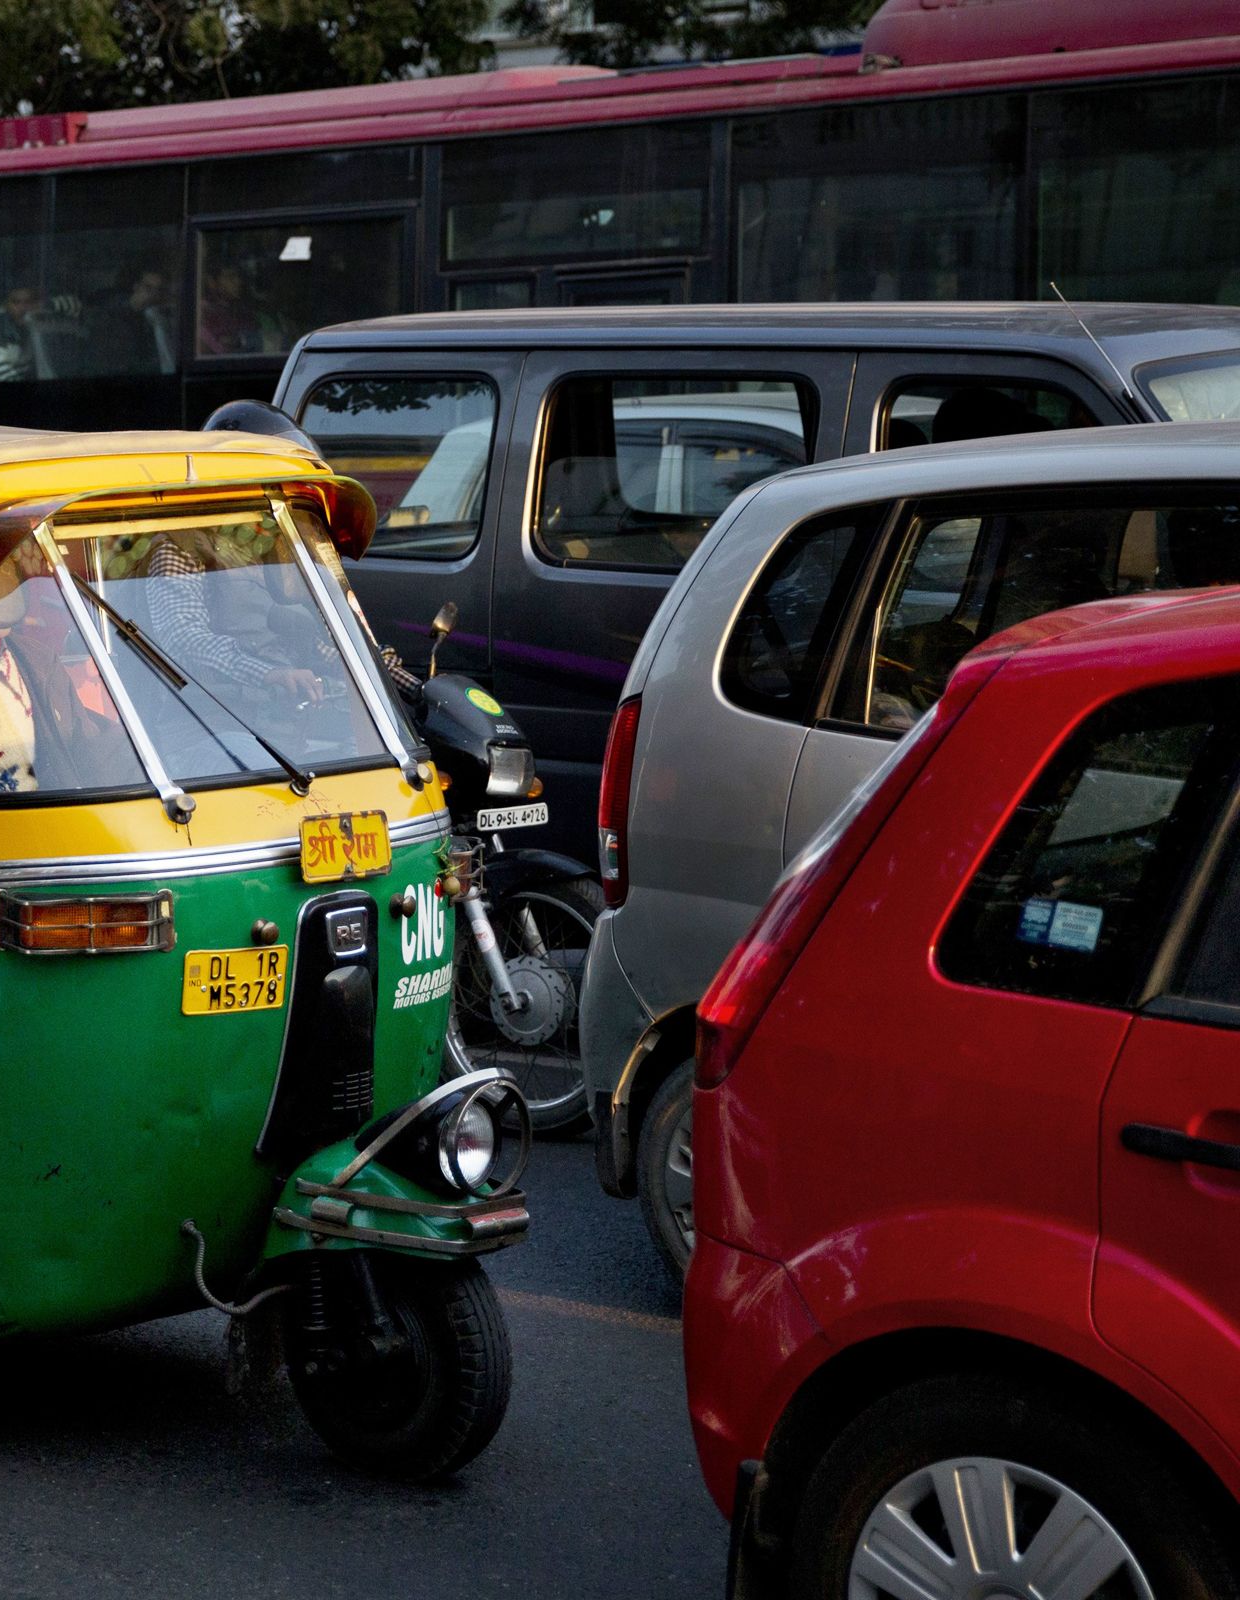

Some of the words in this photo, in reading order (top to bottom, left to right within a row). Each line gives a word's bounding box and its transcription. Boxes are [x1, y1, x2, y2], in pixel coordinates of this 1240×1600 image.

[307, 822, 338, 868] श्री
[340, 831, 379, 866] राम
[336, 922, 362, 946] RE
[402, 883, 445, 965] CNG
[210, 955, 236, 980] DL
[258, 951, 279, 977] 1R
[188, 979, 202, 987] IND
[208, 980, 278, 1011] M5378
[393, 990, 431, 1010] MOTORS
